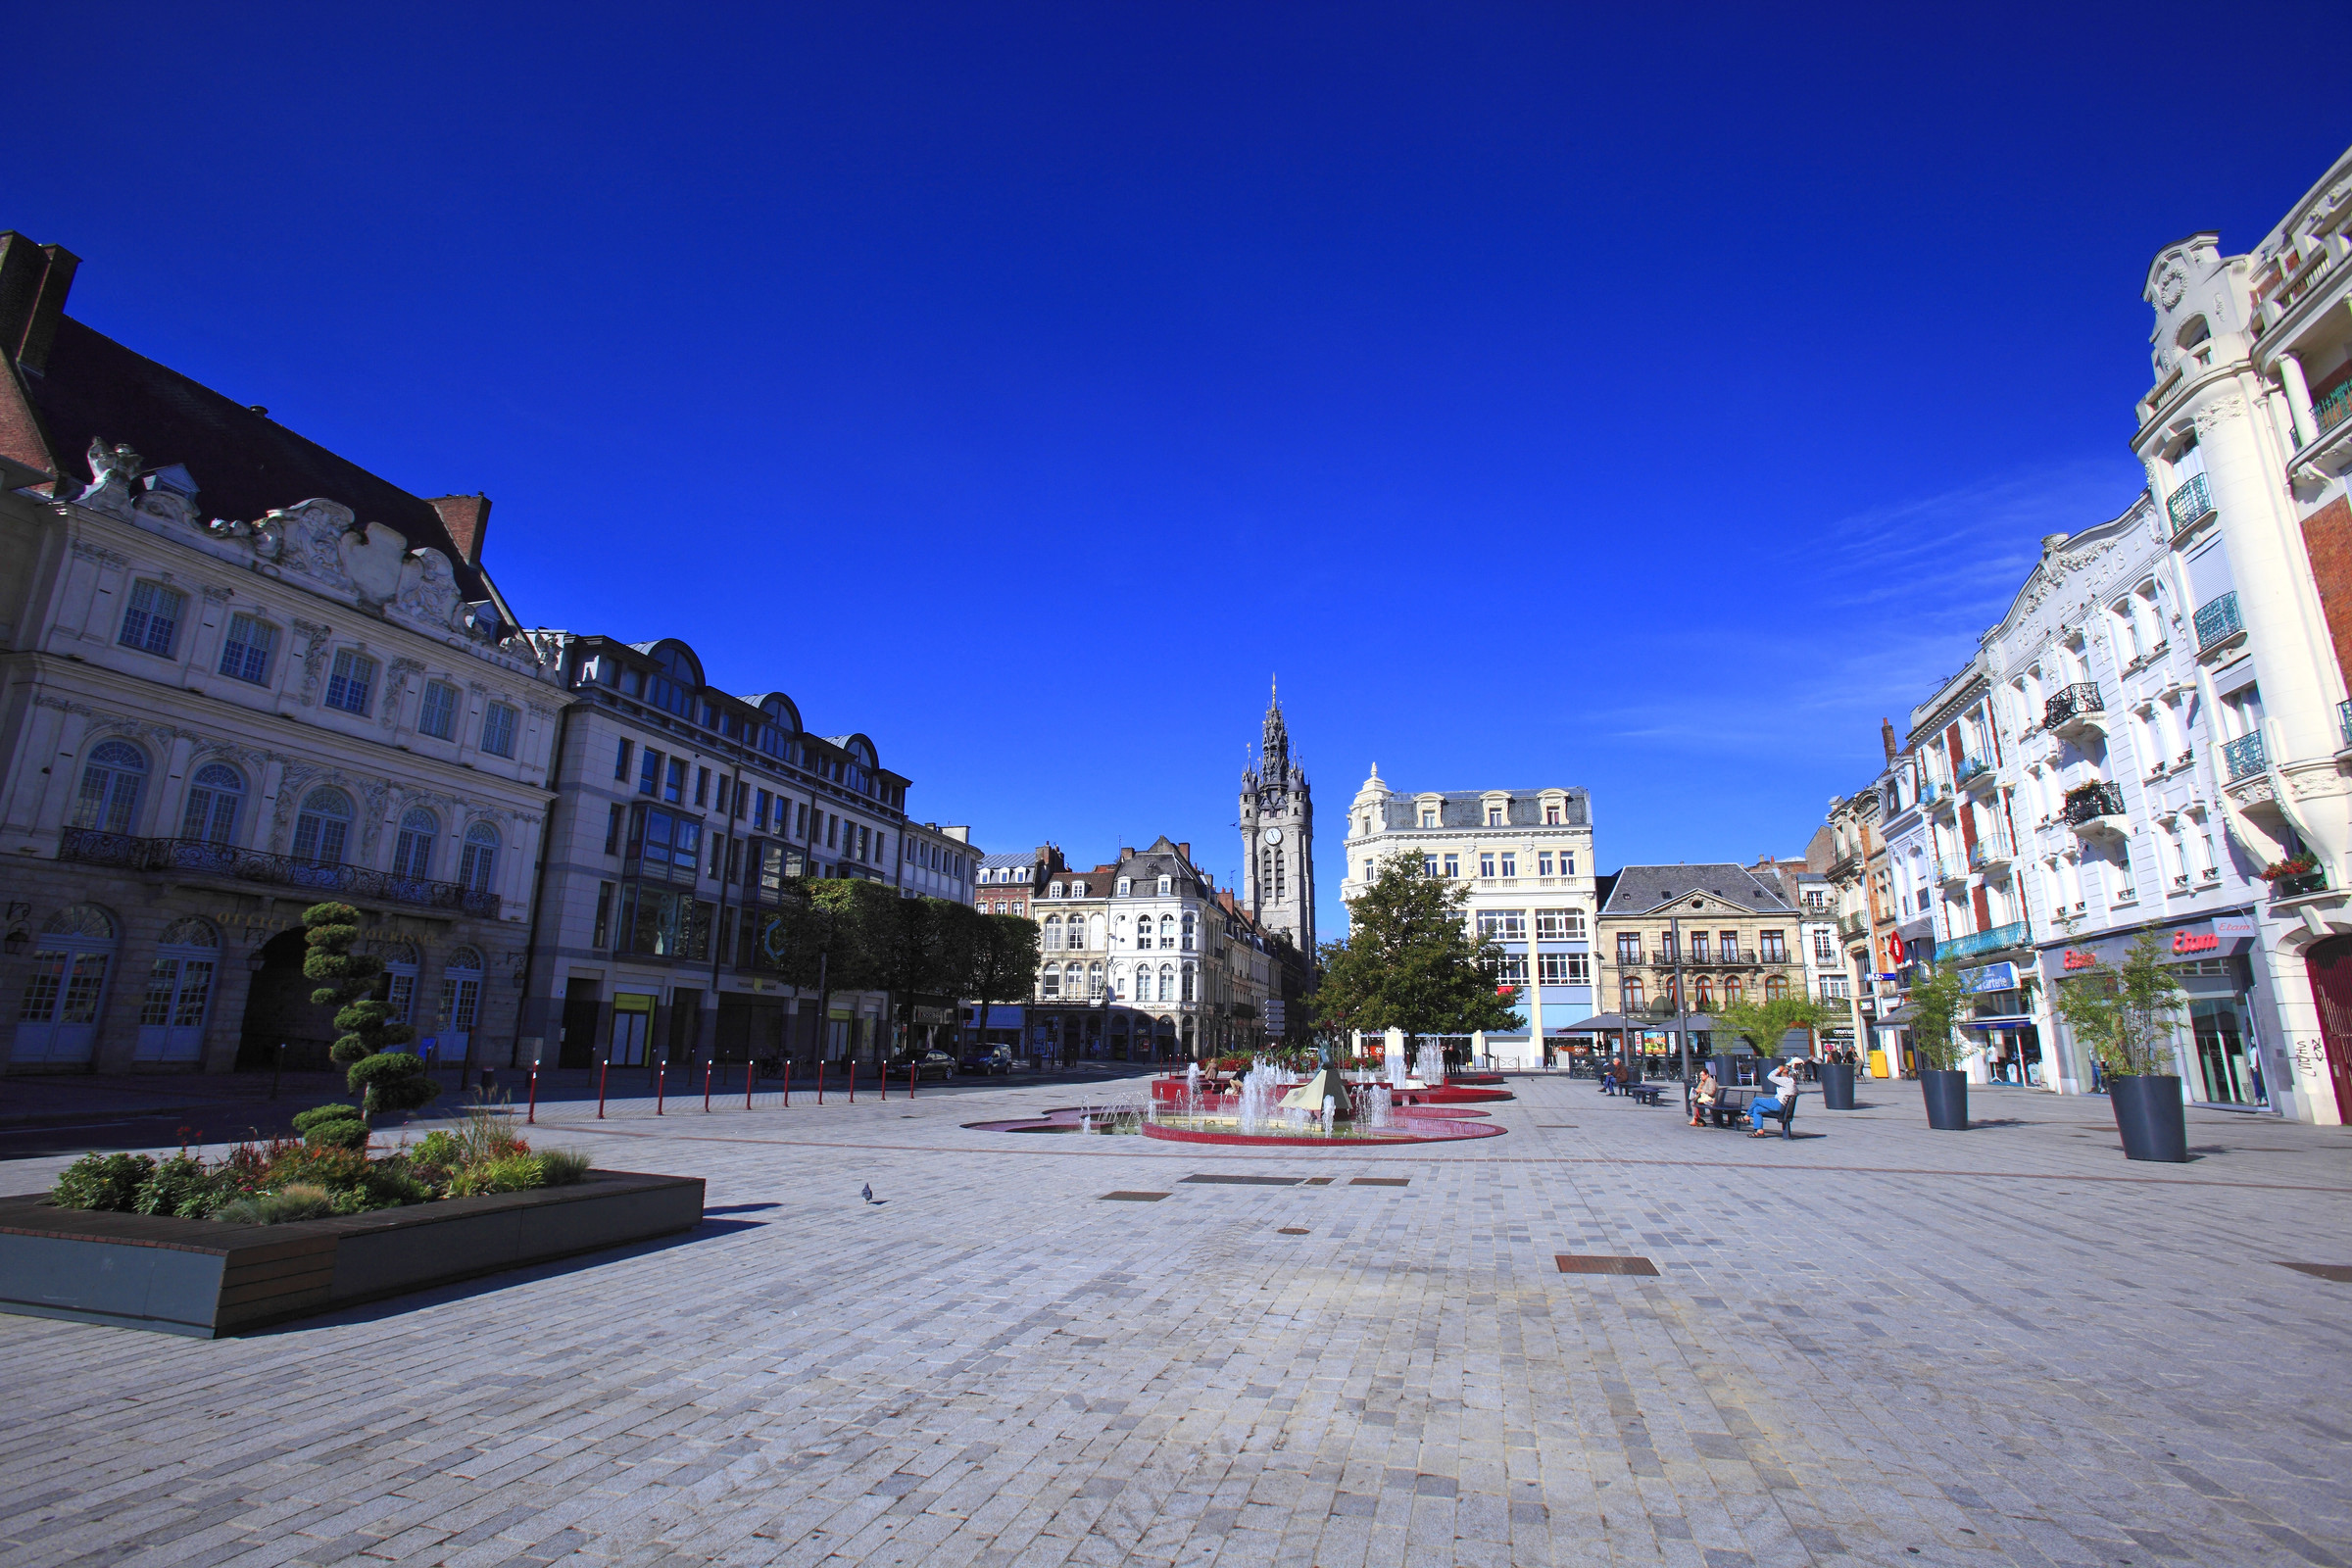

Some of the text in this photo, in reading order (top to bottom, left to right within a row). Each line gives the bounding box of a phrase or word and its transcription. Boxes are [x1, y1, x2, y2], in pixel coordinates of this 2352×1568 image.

[2059, 600, 2076, 618] DE
[2084, 551, 2127, 596] PARIS
[216, 910, 291, 932] OFFICE
[2218, 922, 2251, 932] Etam
[2172, 929, 2220, 955] Etam
[1982, 975, 2009, 990] carterie
